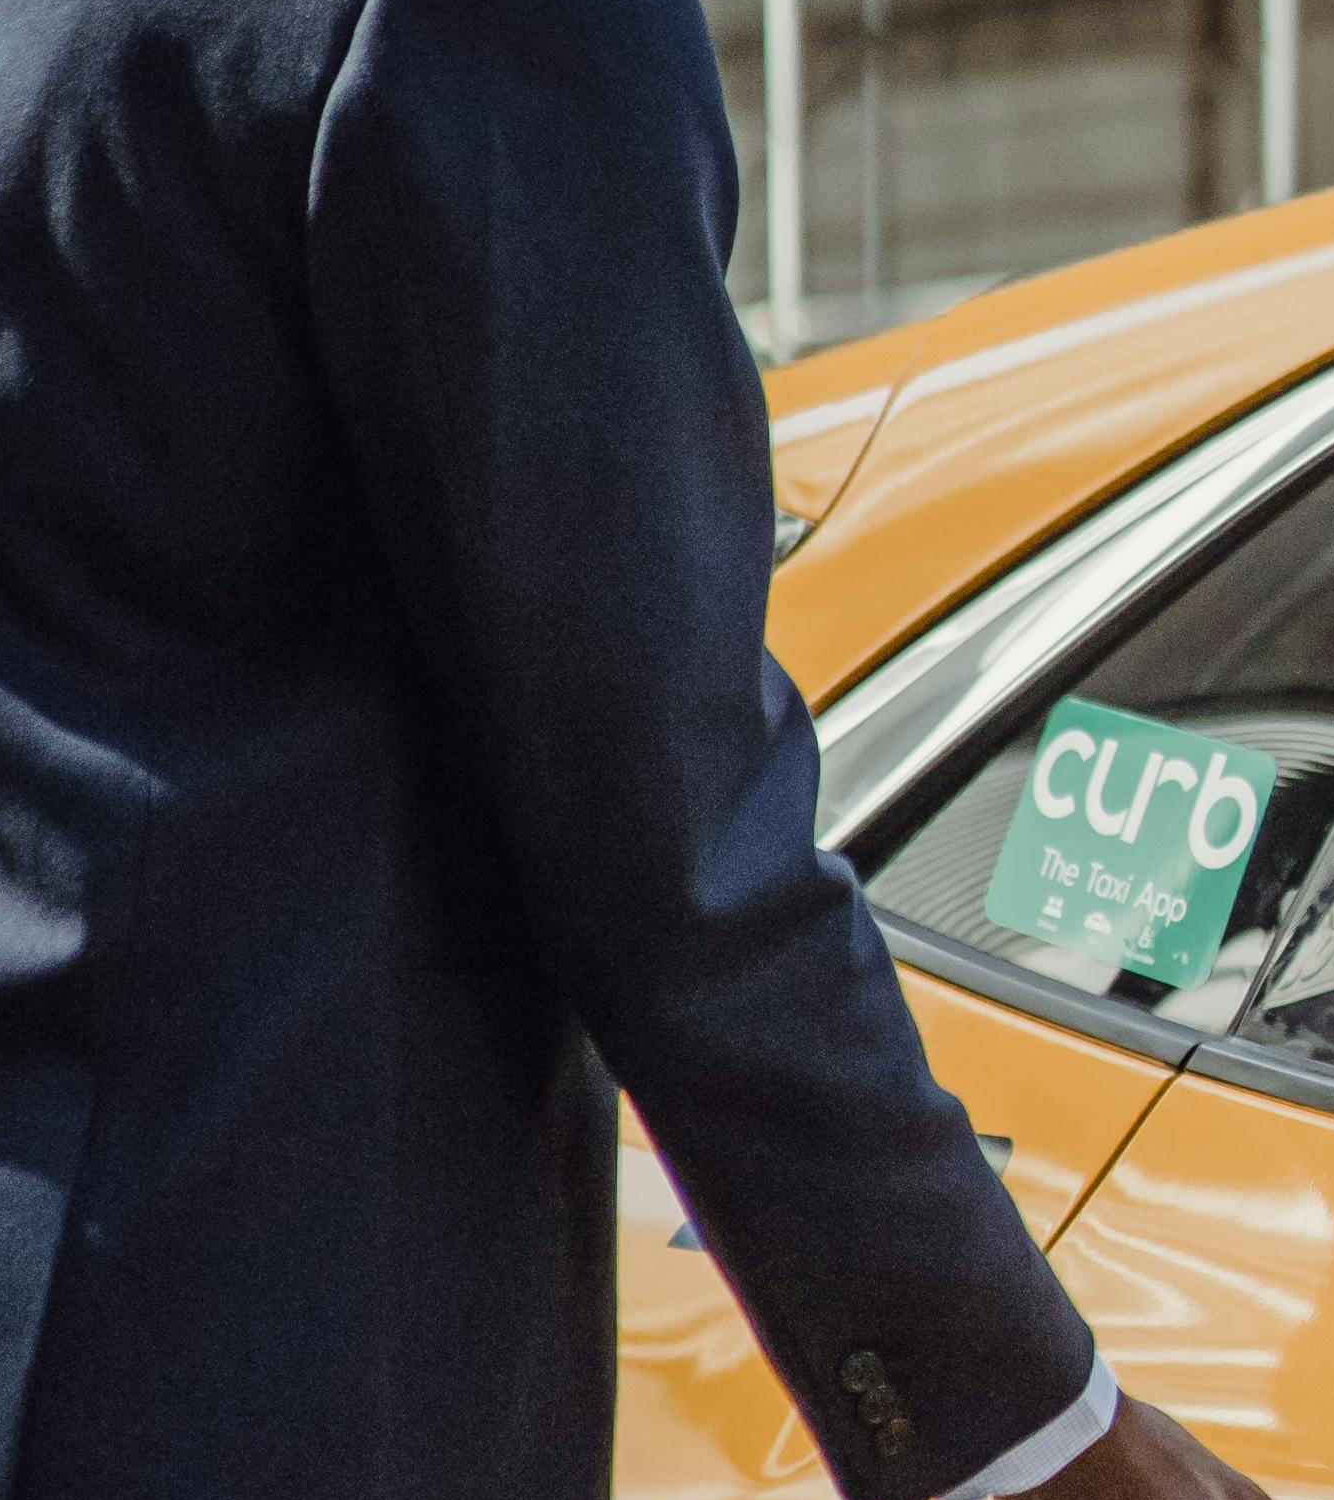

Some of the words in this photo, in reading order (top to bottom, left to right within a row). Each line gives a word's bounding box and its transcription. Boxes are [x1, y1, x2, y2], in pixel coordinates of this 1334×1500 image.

[1032, 729, 1257, 870] curb
[1040, 846, 1080, 887] The
[1086, 861, 1134, 905] Taxi
[1133, 881, 1188, 928] App
